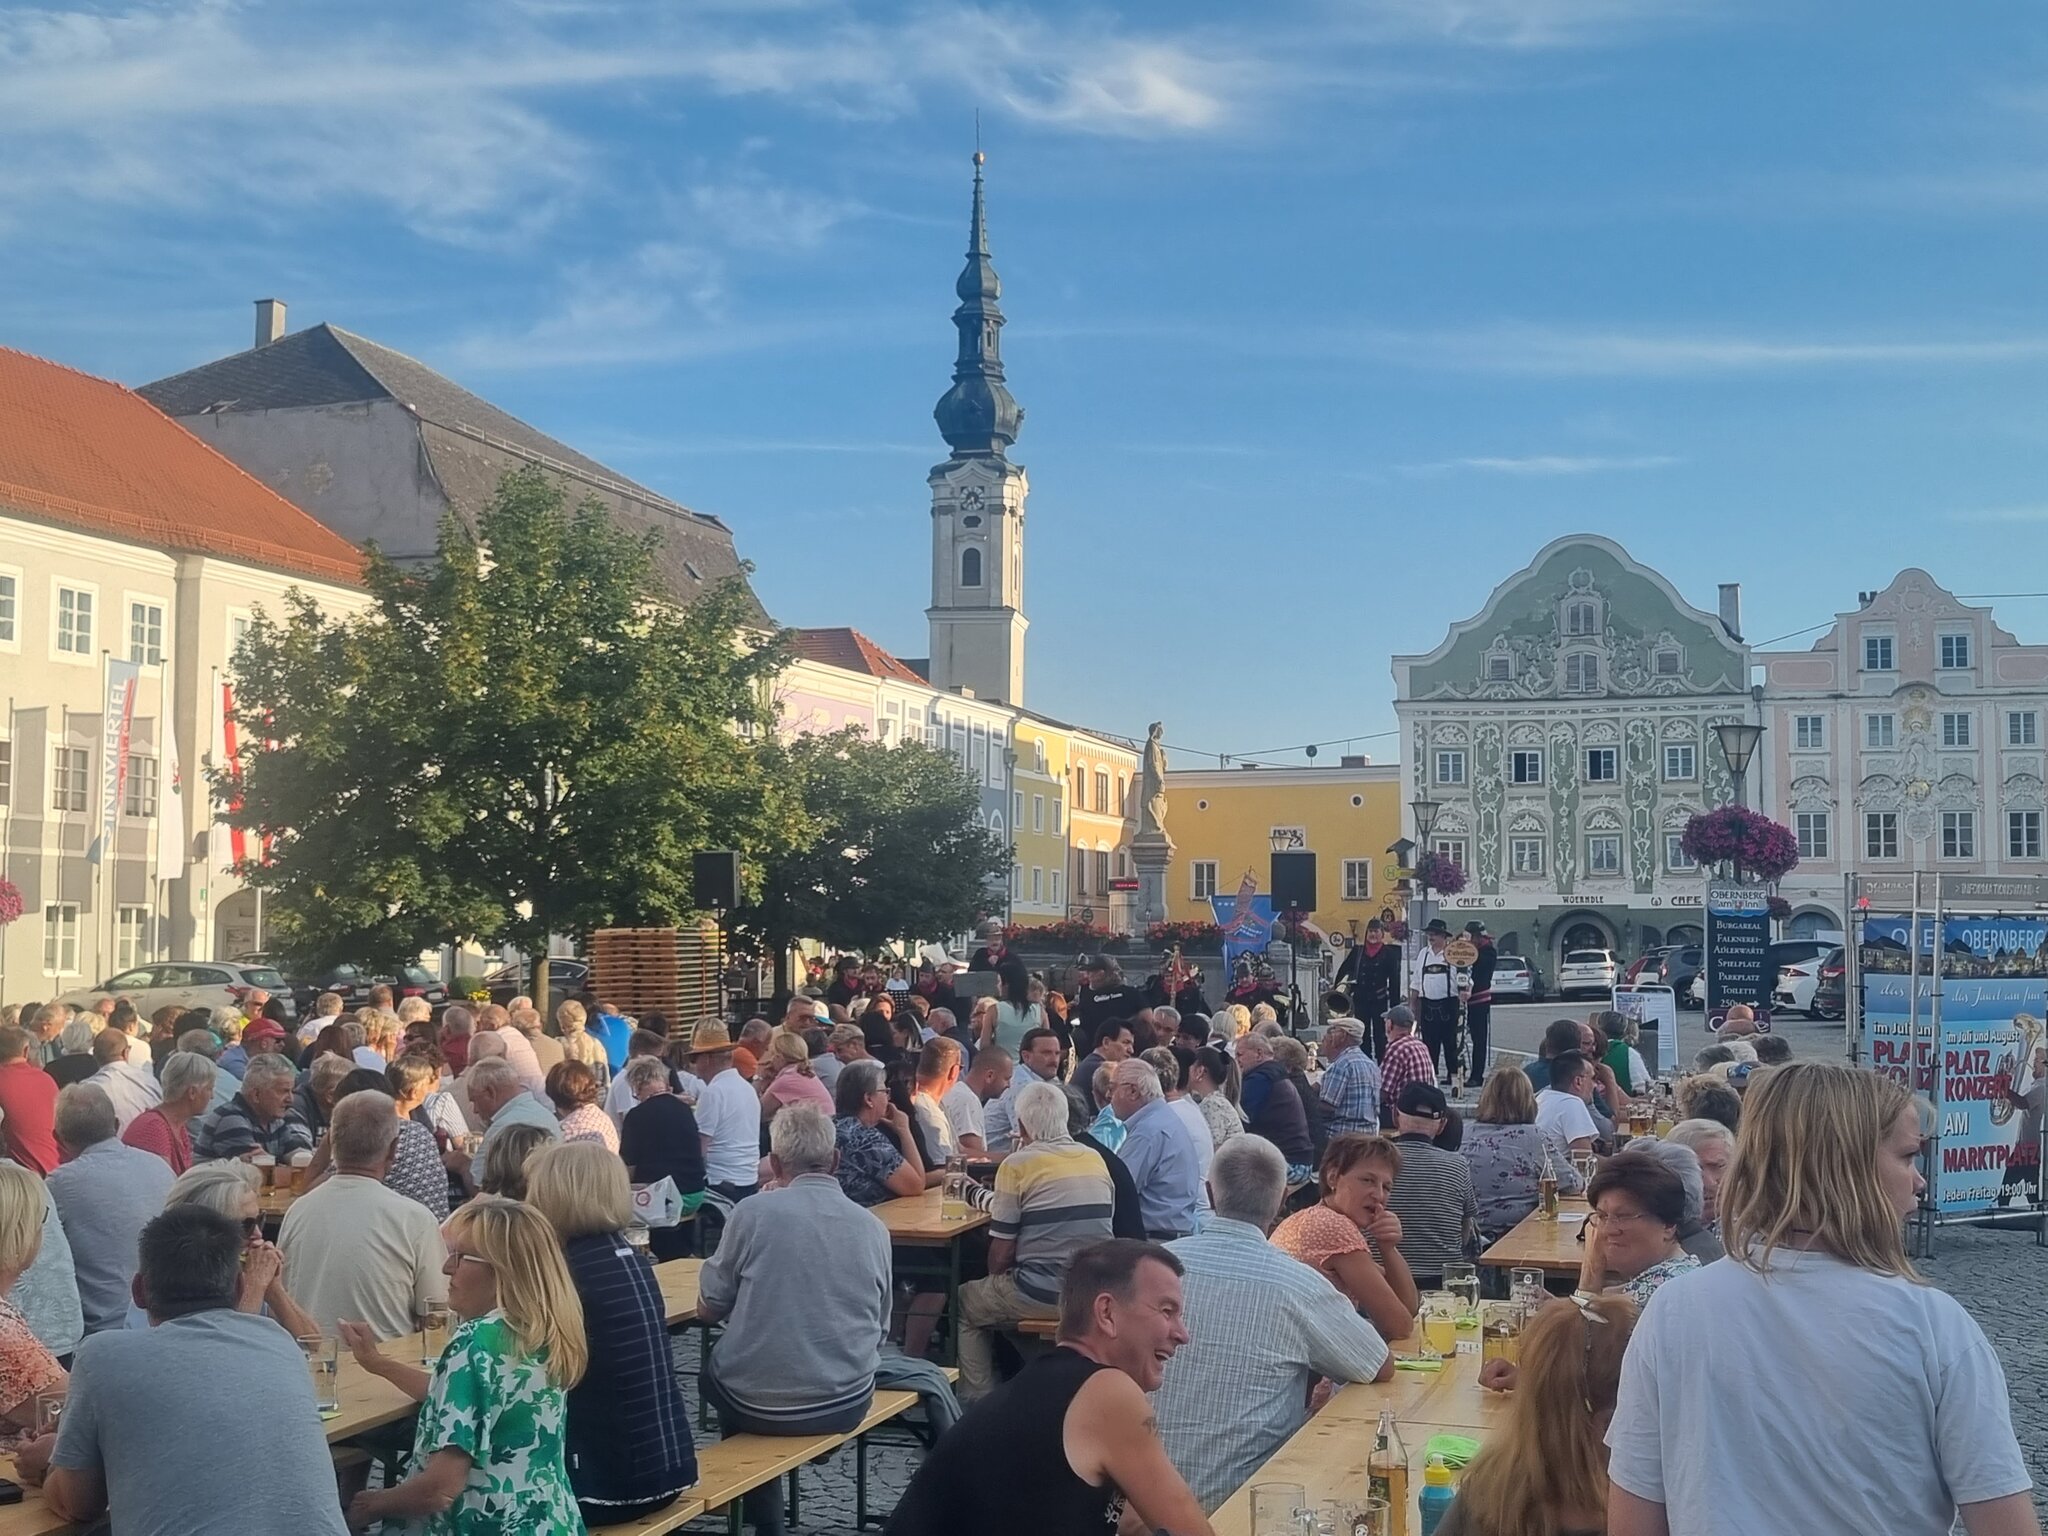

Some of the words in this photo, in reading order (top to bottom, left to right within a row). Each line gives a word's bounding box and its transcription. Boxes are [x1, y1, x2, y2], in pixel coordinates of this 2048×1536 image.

[1711, 890, 1767, 900] OBERNBERG
[1745, 900, 1759, 908] Inn
[1961, 929, 2044, 951] OBERNBERG
[1873, 1020, 1889, 1035] im
[1892, 1021, 1913, 1036] Jul
[1917, 1024, 1940, 1037] un
[1946, 1031, 1957, 1044] im
[1958, 1030, 1972, 1044] Juli
[1974, 1030, 1989, 1043] und
[1991, 1029, 2020, 1046] August
[1873, 1039, 1941, 1067] PLAT
[1945, 1049, 1991, 1076] PLATZ
[1944, 1073, 2013, 1102] KONZERT
[1944, 1111, 1969, 1137] AM
[1943, 1143, 2041, 1174] MARKTPLATZ
[1943, 1188, 1966, 1203] Jeden
[1968, 1184, 1998, 1202] Freitag
[2023, 1180, 2038, 1196] Uhr
